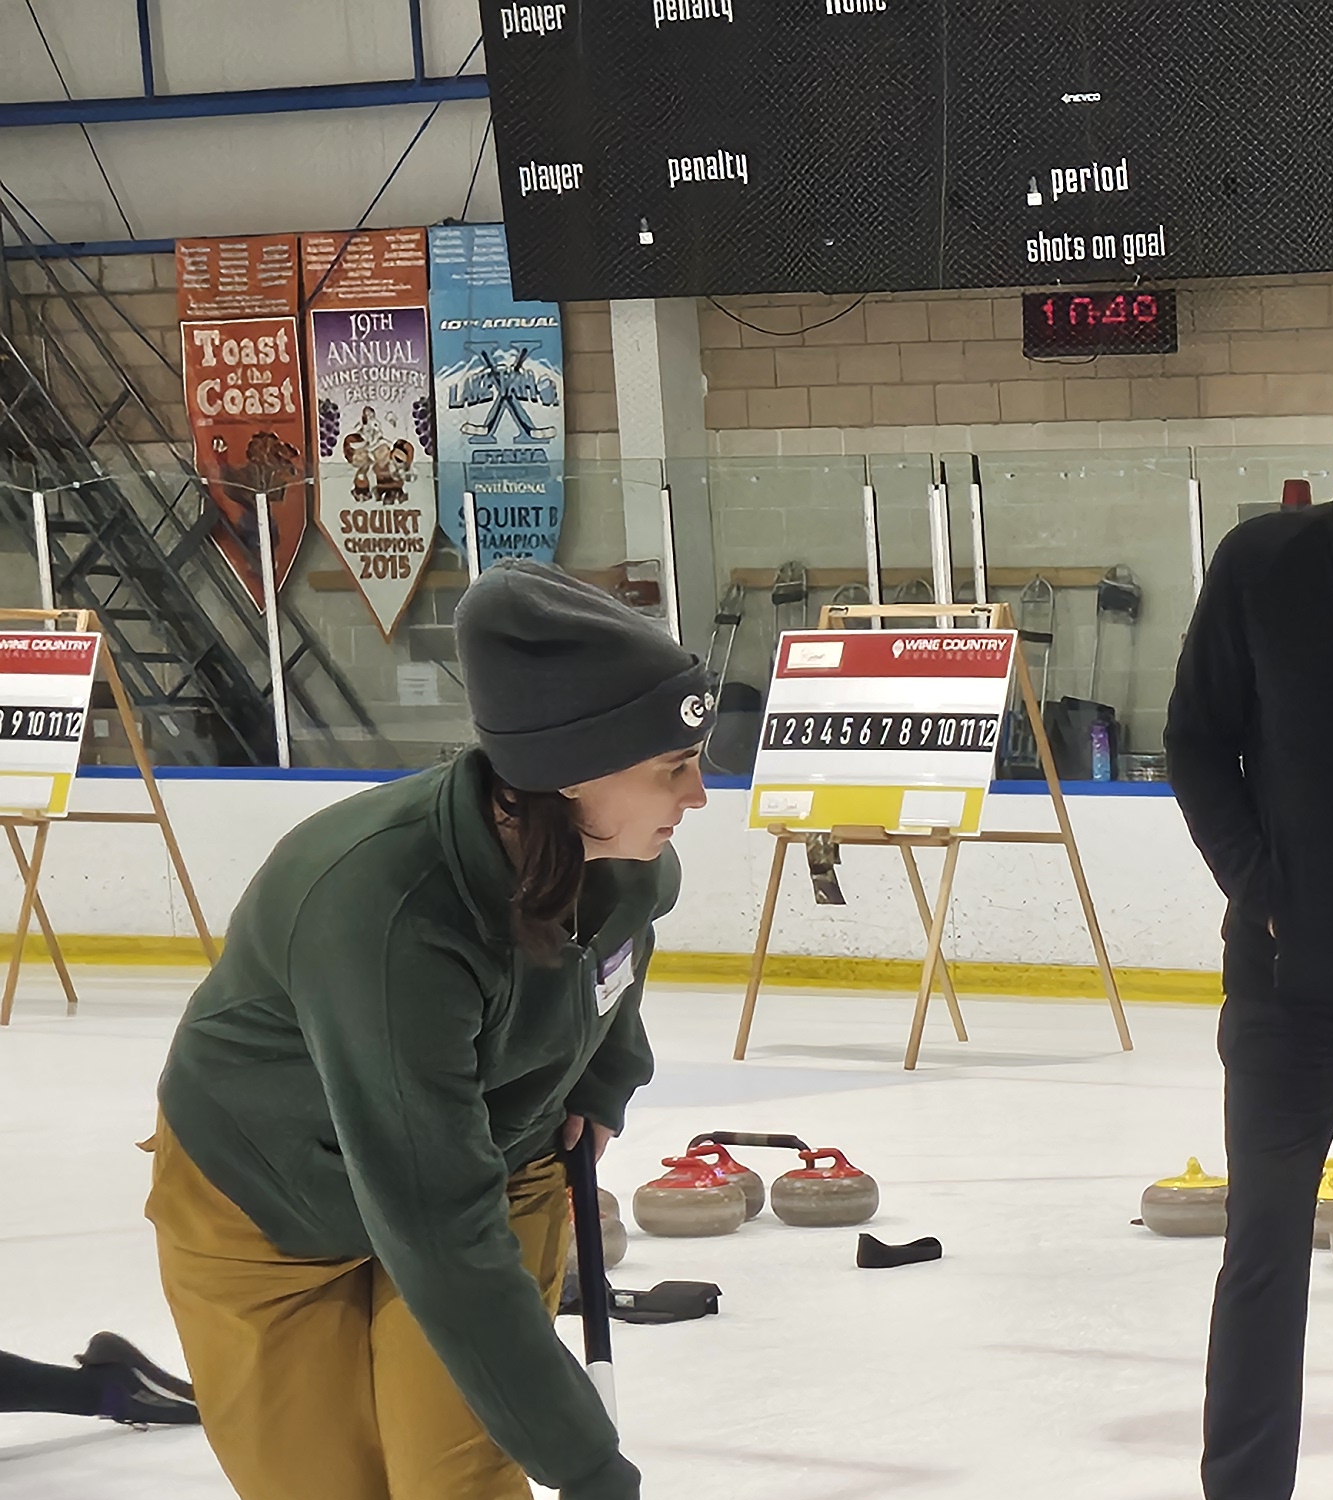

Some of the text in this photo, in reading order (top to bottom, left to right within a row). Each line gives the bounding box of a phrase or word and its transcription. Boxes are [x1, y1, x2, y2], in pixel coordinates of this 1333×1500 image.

[501, 3, 567, 38] player
[518, 158, 583, 196] player
[667, 149, 748, 187] penalty
[1051, 157, 1129, 202] period
[1026, 225, 1167, 266] shots on goal
[349, 313, 394, 341] 19TH
[193, 327, 290, 367] Toast
[327, 340, 420, 366] ANNUAL
[321, 368, 360, 392] WINE
[361, 366, 427, 389] COUNTRY
[196, 377, 296, 416] Coast
[475, 481, 547, 494] INVITATIONAL
[340, 508, 422, 534] SQUIRT
[344, 537, 425, 554] CHAMPIONS
[359, 554, 411, 580] 2015
[31, 639, 91, 651] COUNTRY
[905, 638, 1008, 651] WINE COUNTRY
[11, 709, 83, 738] 9 10 11 12
[769, 717, 998, 746] 1 2 3 4 5 6 7 8 9 10 11 12
